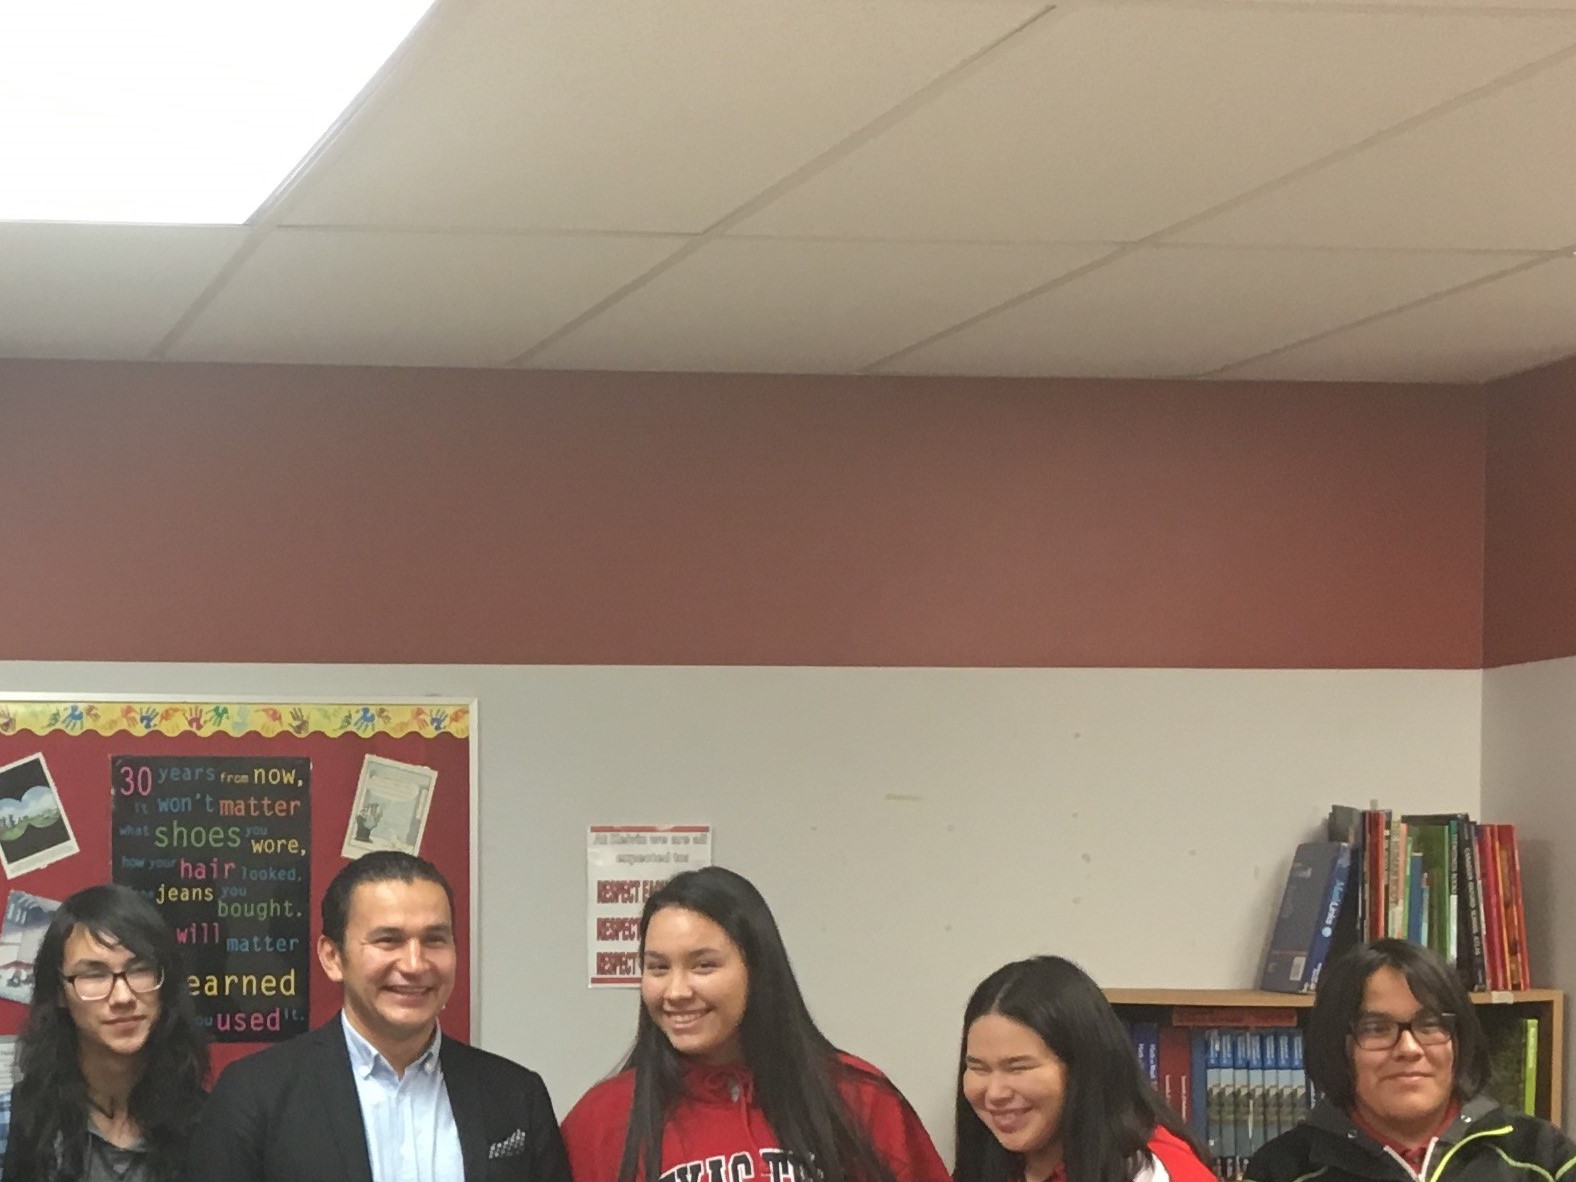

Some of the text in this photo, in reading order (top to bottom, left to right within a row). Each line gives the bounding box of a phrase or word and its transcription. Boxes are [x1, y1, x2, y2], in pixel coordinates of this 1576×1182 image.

[120, 766, 304, 796] 30 years from now,
[157, 793, 214, 813] won't
[219, 796, 301, 817] matter
[154, 820, 241, 848] shoes
[251, 838, 307, 857] wore,
[180, 857, 236, 880] hair
[241, 866, 302, 882] looked,
[156, 883, 214, 904] jeans
[217, 899, 303, 921] bought.
[176, 922, 219, 944] will
[226, 935, 299, 953] matter
[216, 1008, 281, 1032] used
